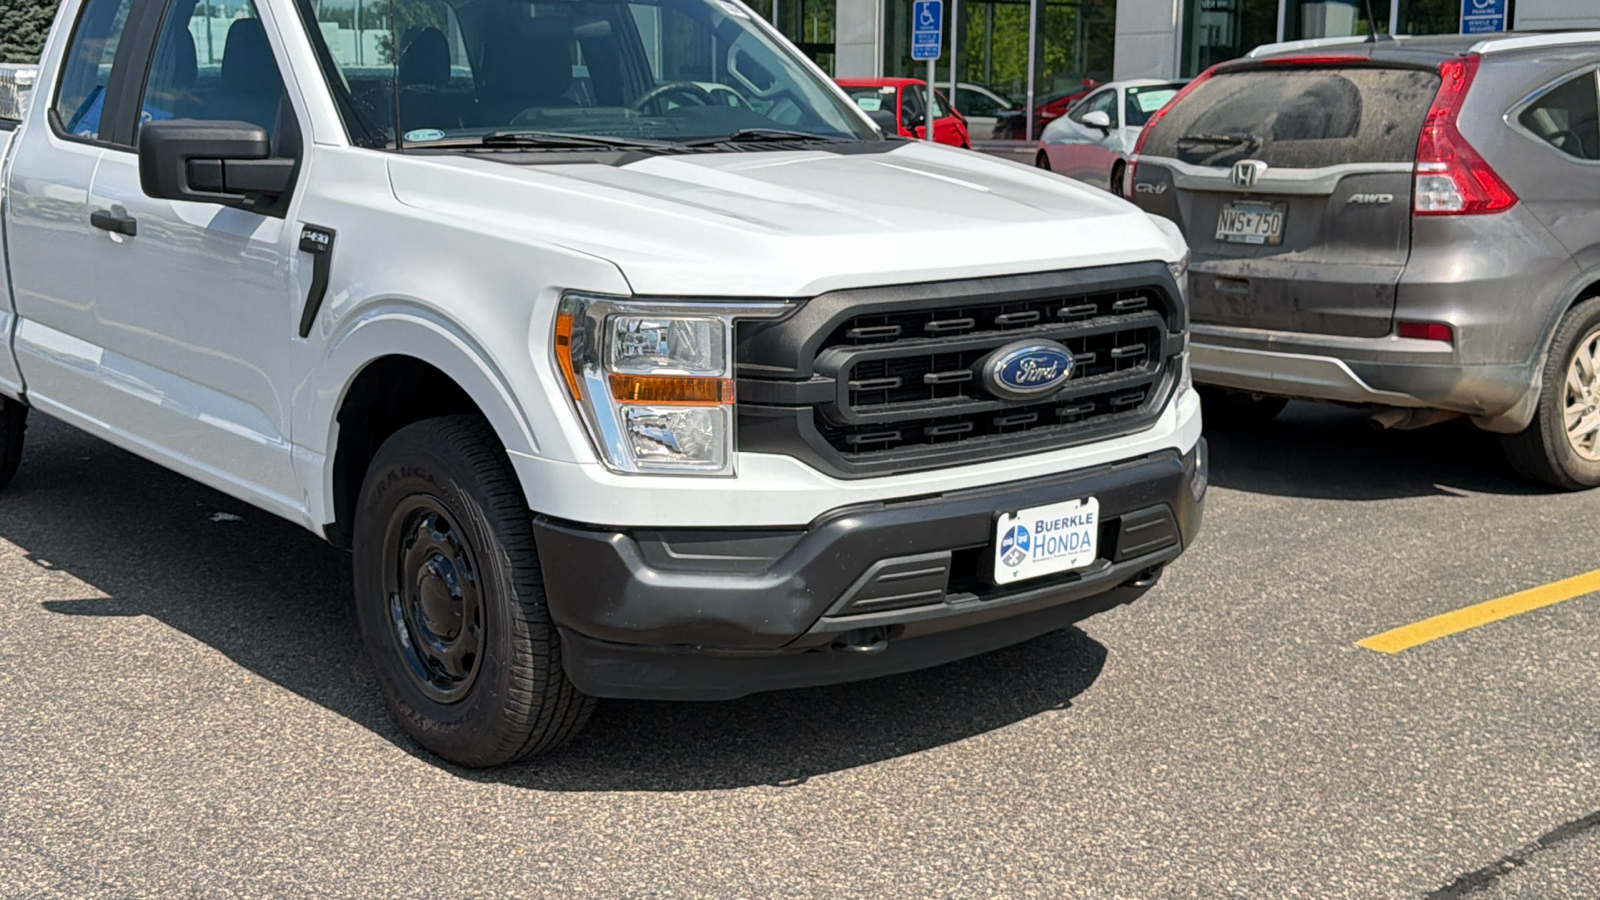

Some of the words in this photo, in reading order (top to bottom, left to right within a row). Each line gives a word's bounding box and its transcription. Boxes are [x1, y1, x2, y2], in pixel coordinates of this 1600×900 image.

[1347, 193, 1394, 204] AWD
[1015, 356, 1059, 384] Ford
[1034, 512, 1094, 535] BUERKLE
[1032, 530, 1092, 559] HONDA
